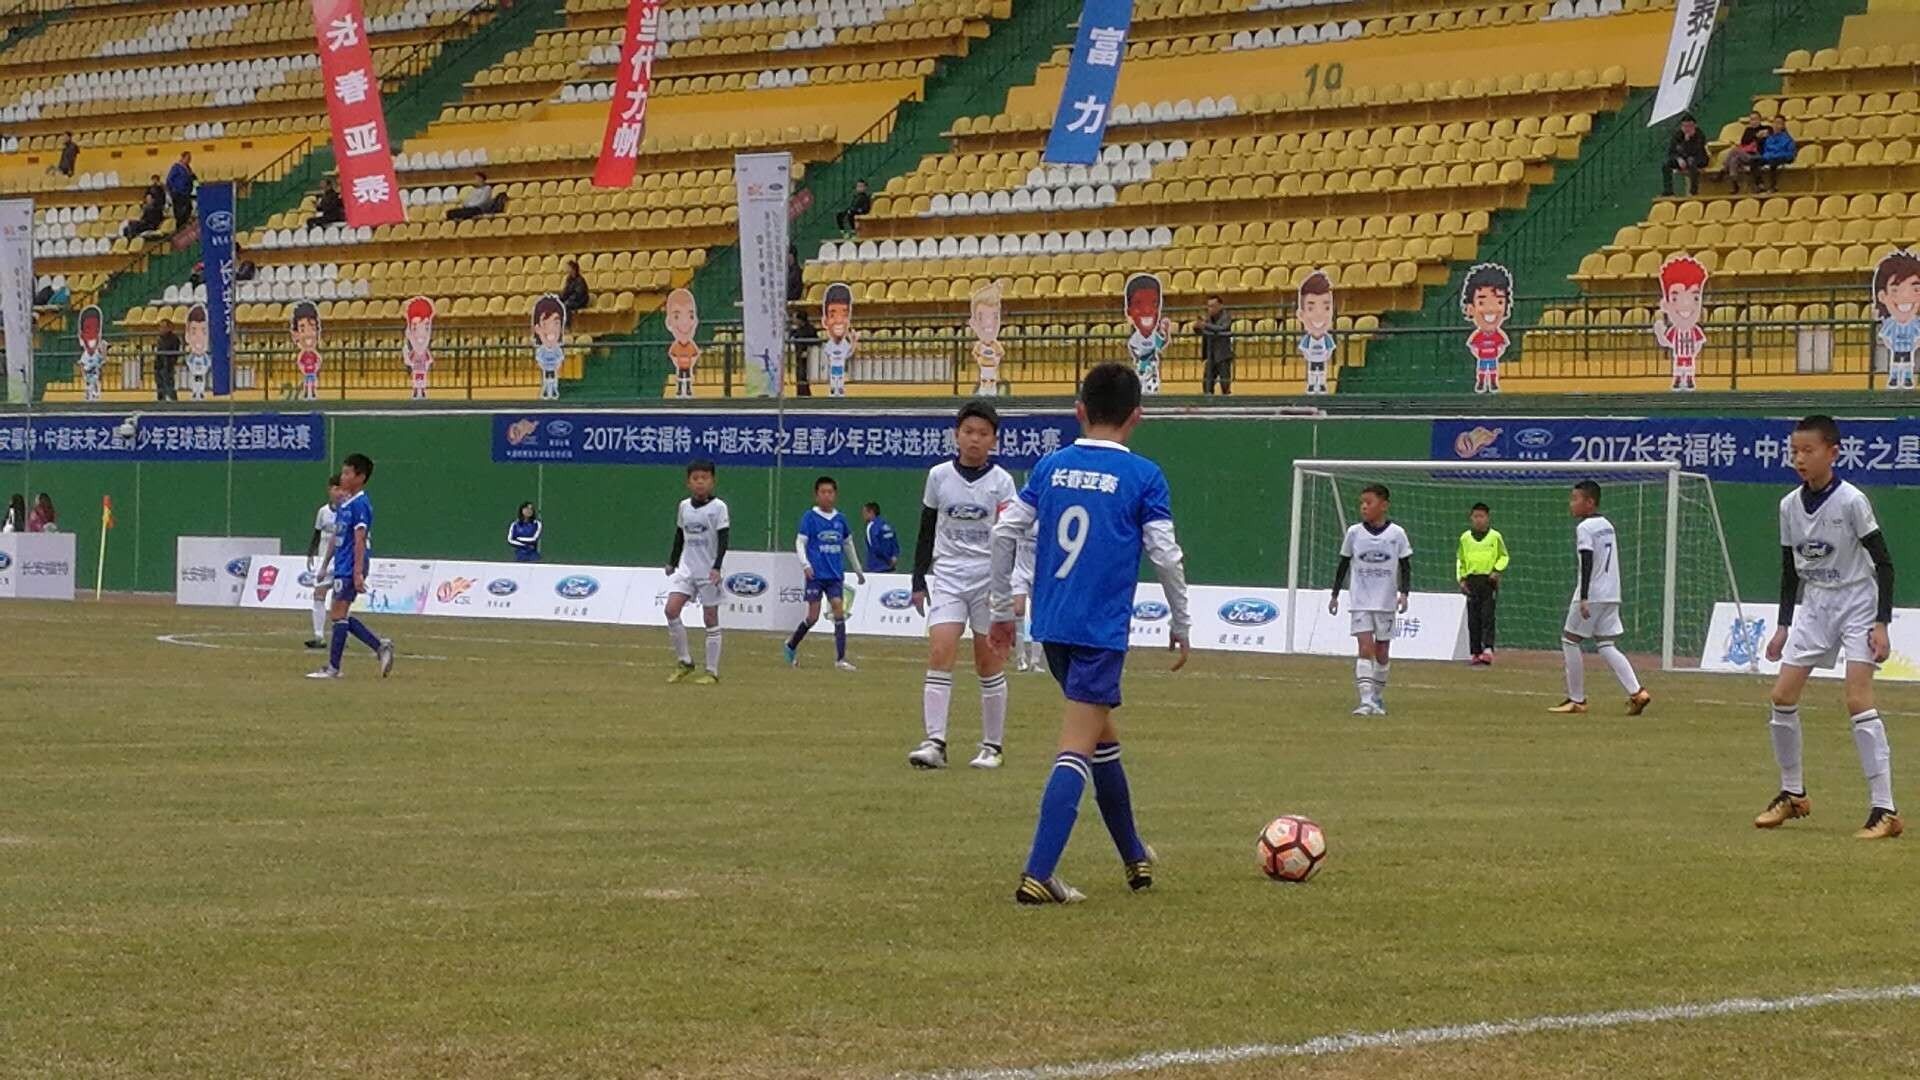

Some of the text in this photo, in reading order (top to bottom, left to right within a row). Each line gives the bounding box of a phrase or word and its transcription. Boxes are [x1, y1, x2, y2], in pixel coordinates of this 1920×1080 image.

[1066, 26, 1125, 134] 富力
[1304, 62, 1343, 100] 10
[583, 425, 1062, 458] 2017长安福特·中超未来之星青少年足球选拔赛总决赛
[1570, 432, 1920, 471] 2017长安福特·中来之星
[1051, 468, 1119, 495] 长春亚泰
[1054, 505, 1090, 579] 9
[1604, 543, 1612, 573] 7
